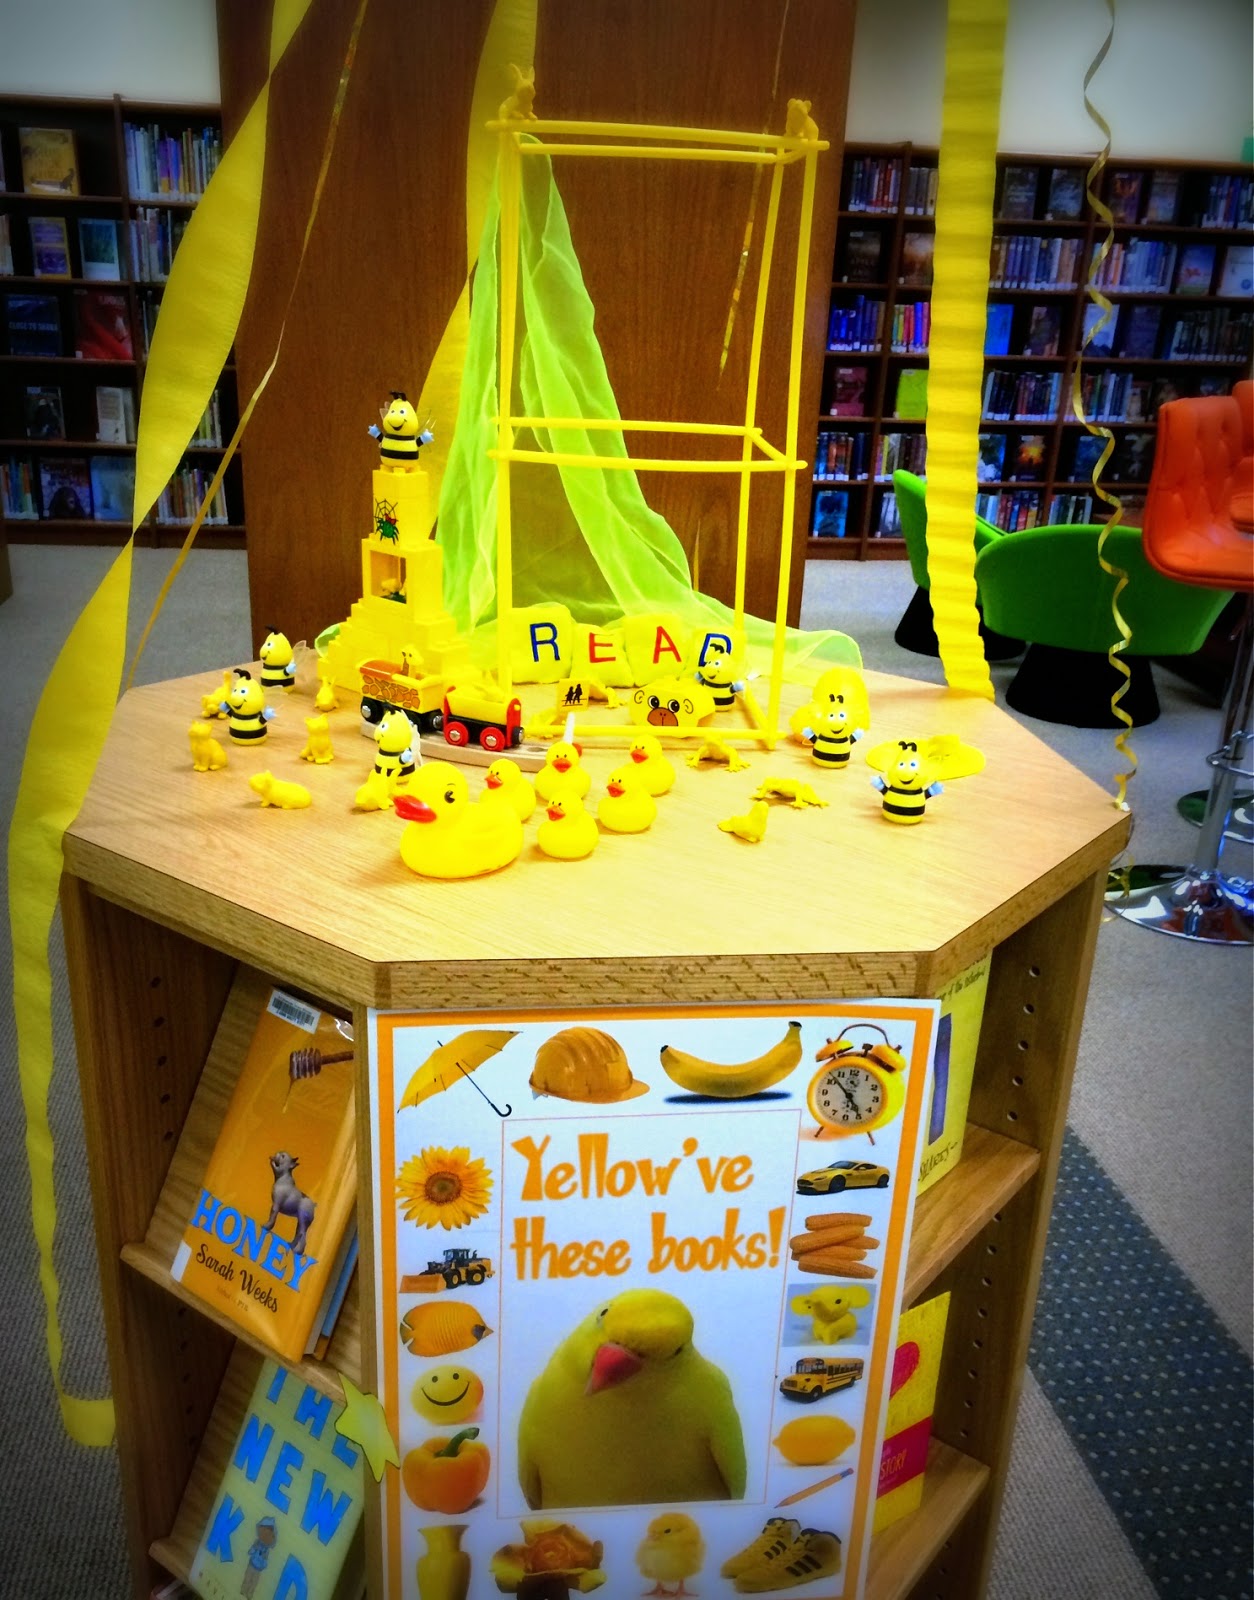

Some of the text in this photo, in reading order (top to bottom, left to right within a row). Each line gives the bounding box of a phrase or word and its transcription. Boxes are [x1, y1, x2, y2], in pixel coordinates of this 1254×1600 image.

[837, 1071, 846, 1079] 11
[849, 1069, 860, 1077] 12
[864, 1074, 870, 1082] 1
[821, 1088, 829, 1096] 9
[870, 1084, 878, 1092] 2
[871, 1095, 879, 1103] 3
[865, 1106, 873, 1114] 4
[510, 1133, 754, 1201] Yellow've
[190, 1188, 319, 1292] HONEY
[510, 1205, 787, 1280] these books!
[196, 1243, 234, 1281] Sarah
[240, 1269, 278, 1313] Weeks
[232, 1413, 353, 1547] NEW
